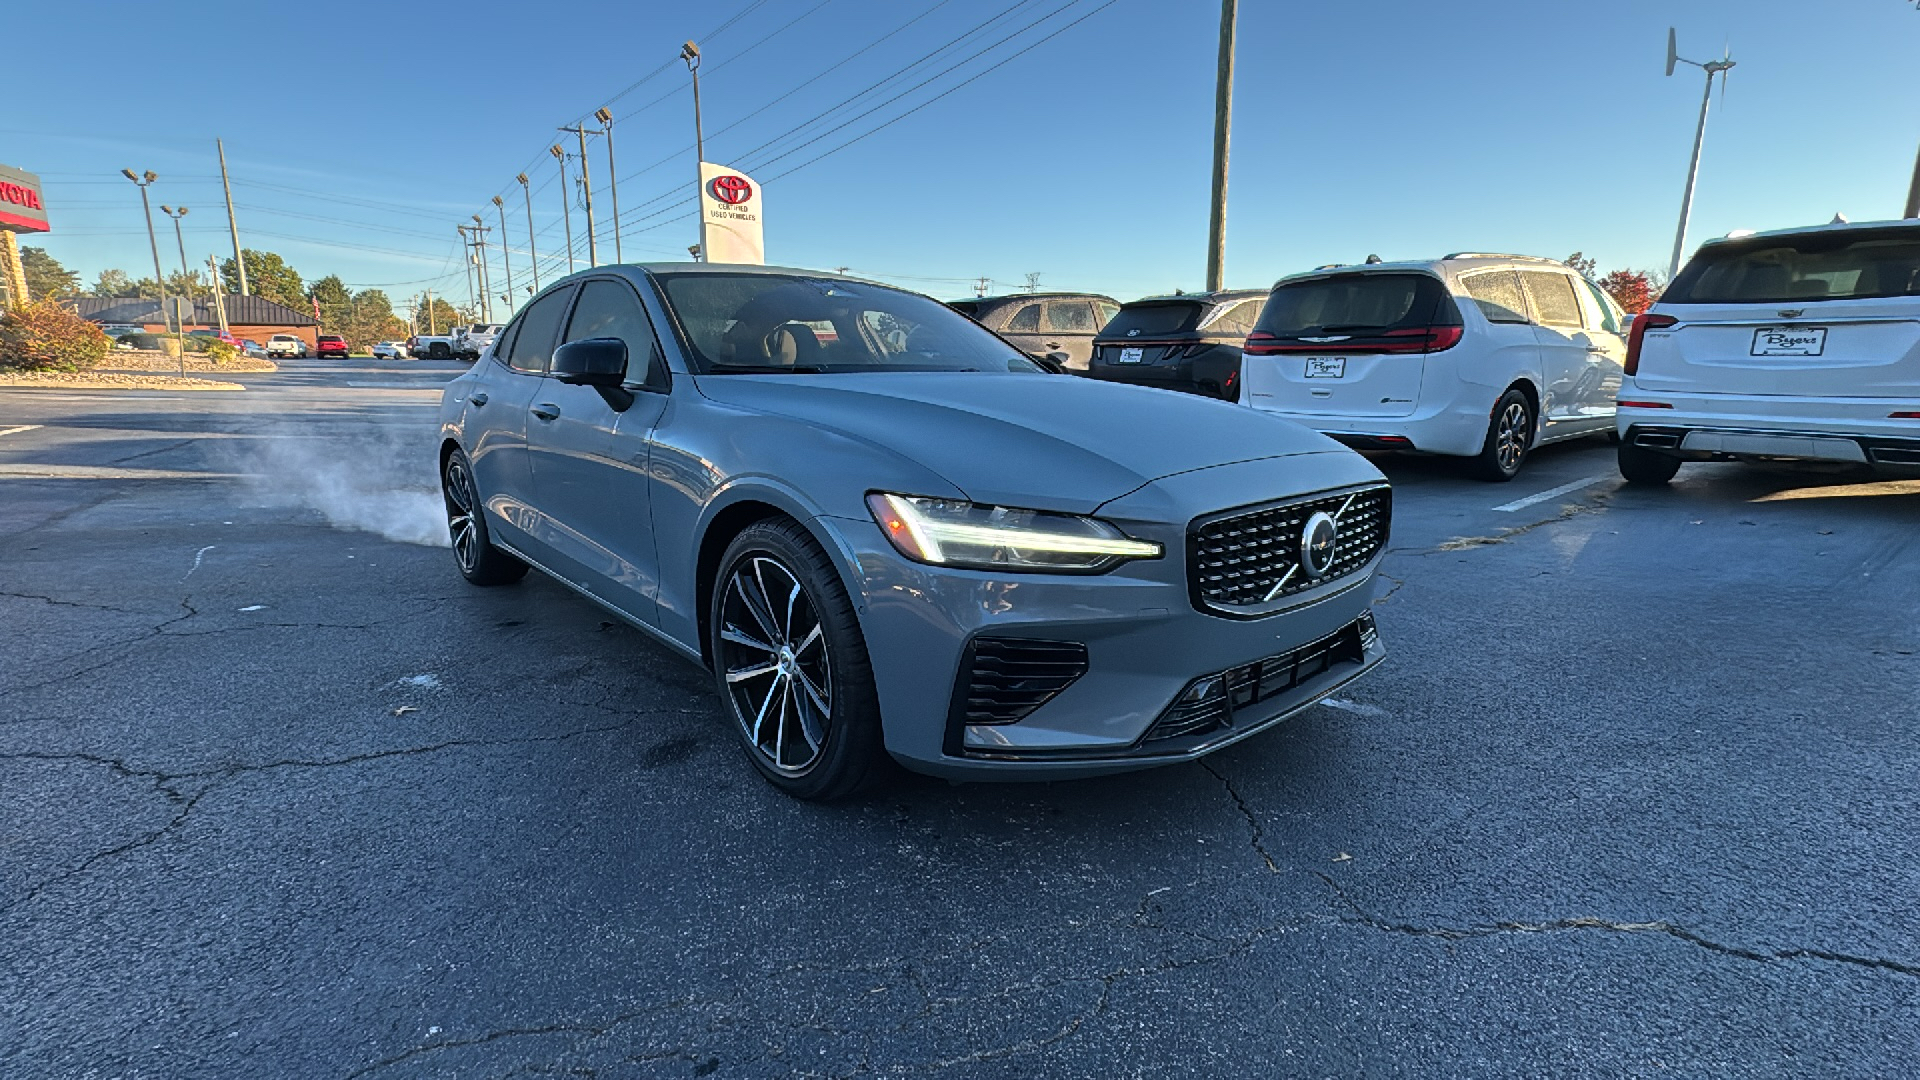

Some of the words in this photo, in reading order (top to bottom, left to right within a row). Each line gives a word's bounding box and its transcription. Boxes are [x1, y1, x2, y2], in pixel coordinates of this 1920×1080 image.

[718, 203, 748, 212] CERTIFIED
[728, 212, 756, 221] VEHICLES
[1762, 334, 1816, 347] Byers
